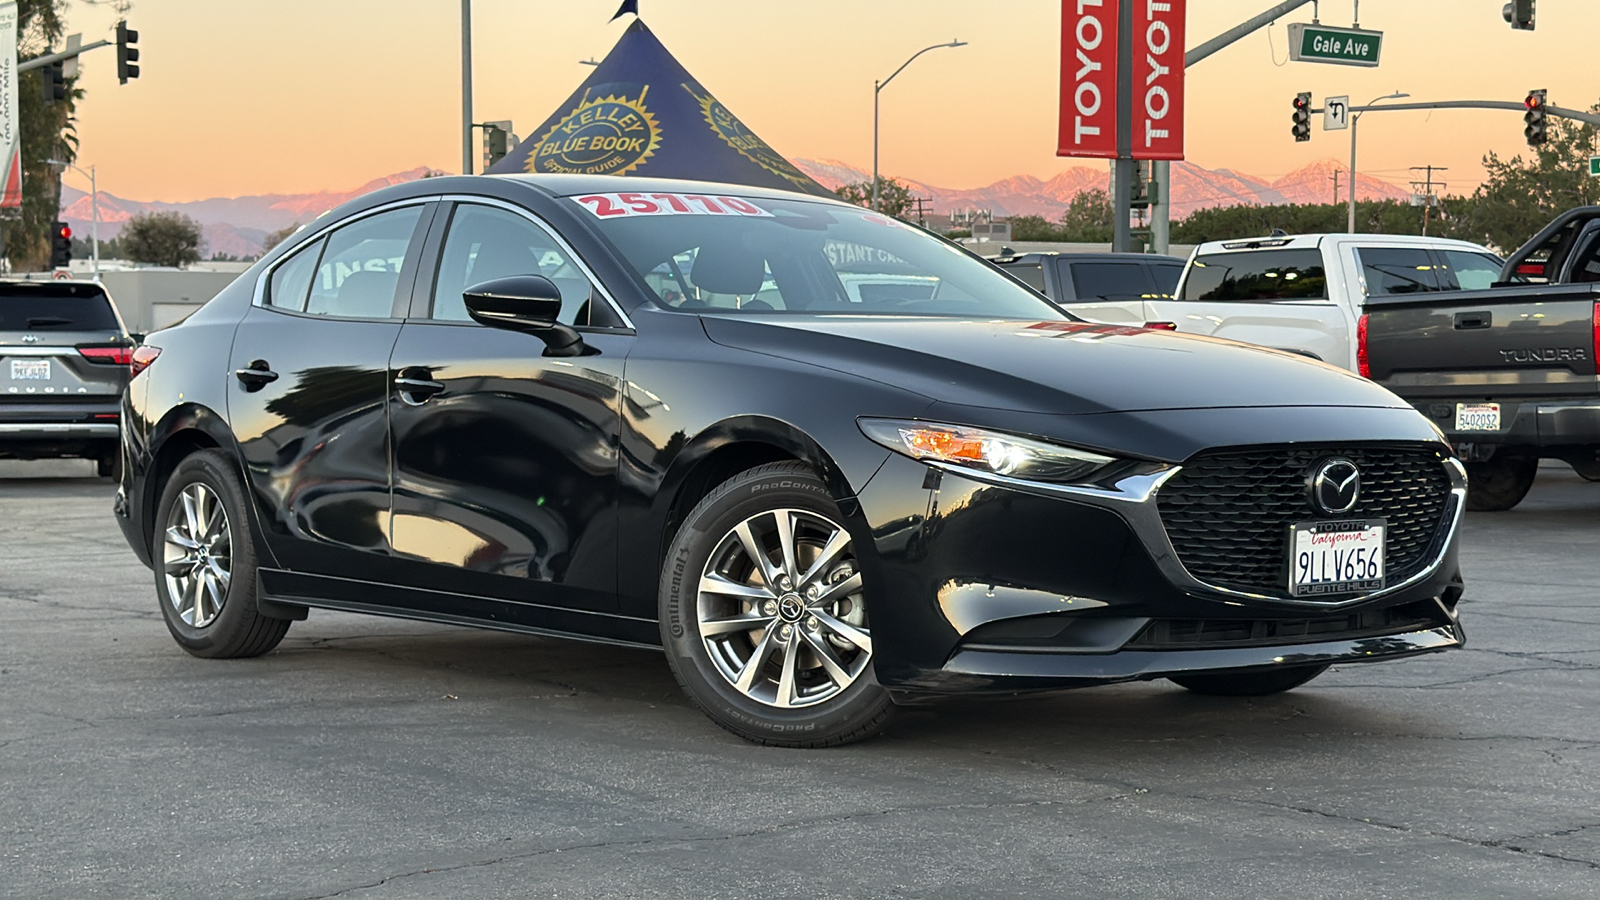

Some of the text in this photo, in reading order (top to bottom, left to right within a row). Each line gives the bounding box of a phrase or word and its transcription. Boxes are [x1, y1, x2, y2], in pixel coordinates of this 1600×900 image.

[1313, 35, 1369, 56] Gale Ave
[1074, 0, 1103, 144] TOYOT
[1145, 0, 1171, 147] TOYOT
[562, 107, 644, 134] KELLEY
[540, 136, 646, 157] BLUE BOOK
[586, 155, 626, 174] GUIDE
[578, 193, 763, 216] 25770
[824, 242, 873, 266] STANT
[320, 256, 404, 291] INST
[1500, 347, 1587, 362] TUNDRA
[751, 480, 833, 499] PROCONTA
[1316, 522, 1365, 532] TOYOTA
[1311, 531, 1368, 549] California
[1299, 547, 1378, 583] 9LLV656
[668, 557, 687, 639] Continental
[1298, 580, 1380, 594] PUENTE HILLS
